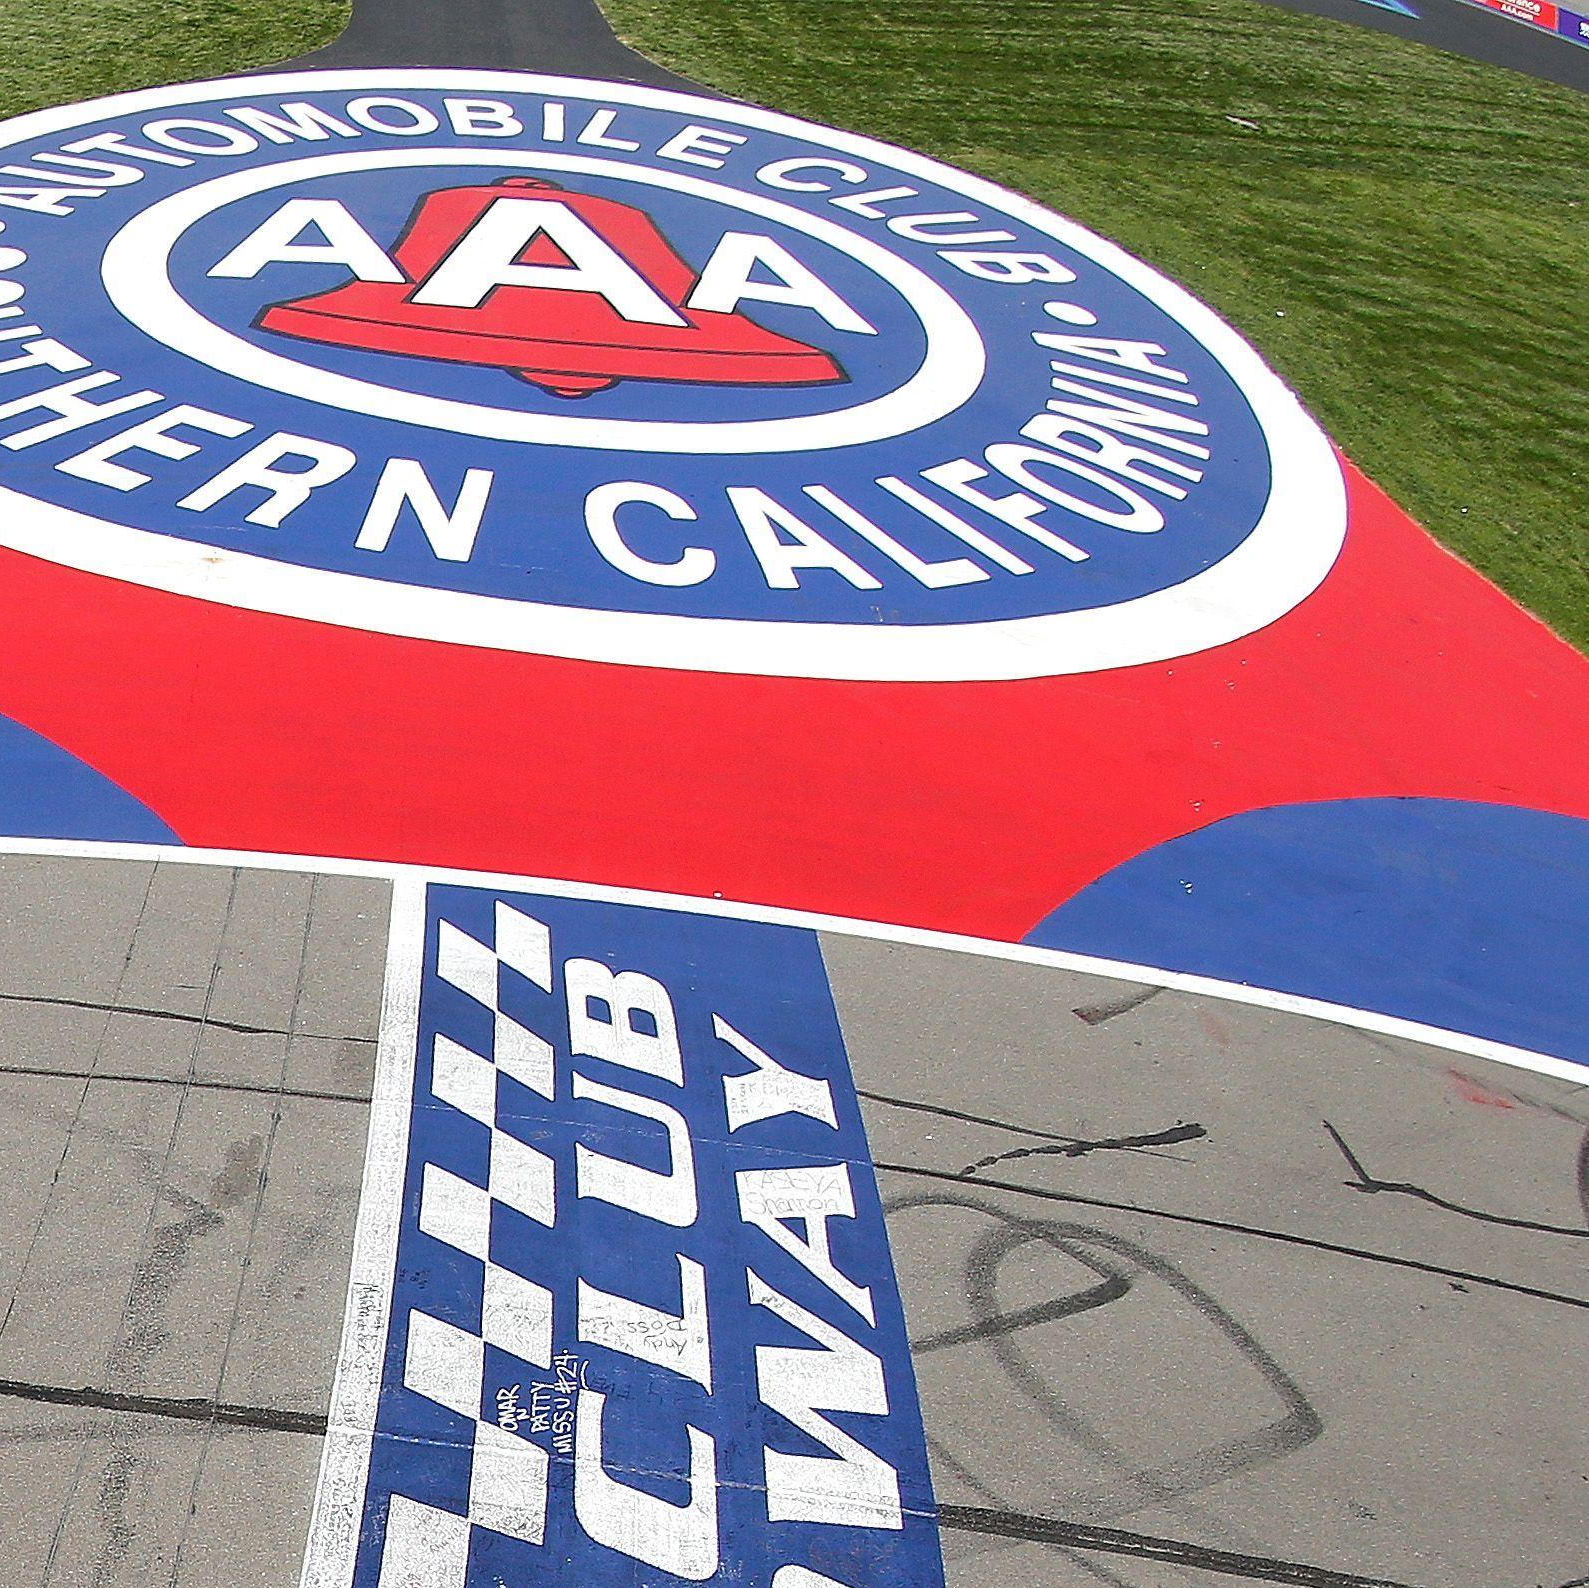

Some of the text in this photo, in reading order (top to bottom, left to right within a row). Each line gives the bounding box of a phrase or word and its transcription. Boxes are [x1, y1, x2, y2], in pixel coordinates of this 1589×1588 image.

[205, 195, 876, 334] AAA
[777, 155, 1073, 290] CLUB
[583, 330, 1211, 593] CALIFORNIA
[563, 955, 718, 1581] CLUB
[496, 1384, 521, 1433] OMAR
[530, 1379, 555, 1432] PATTY
